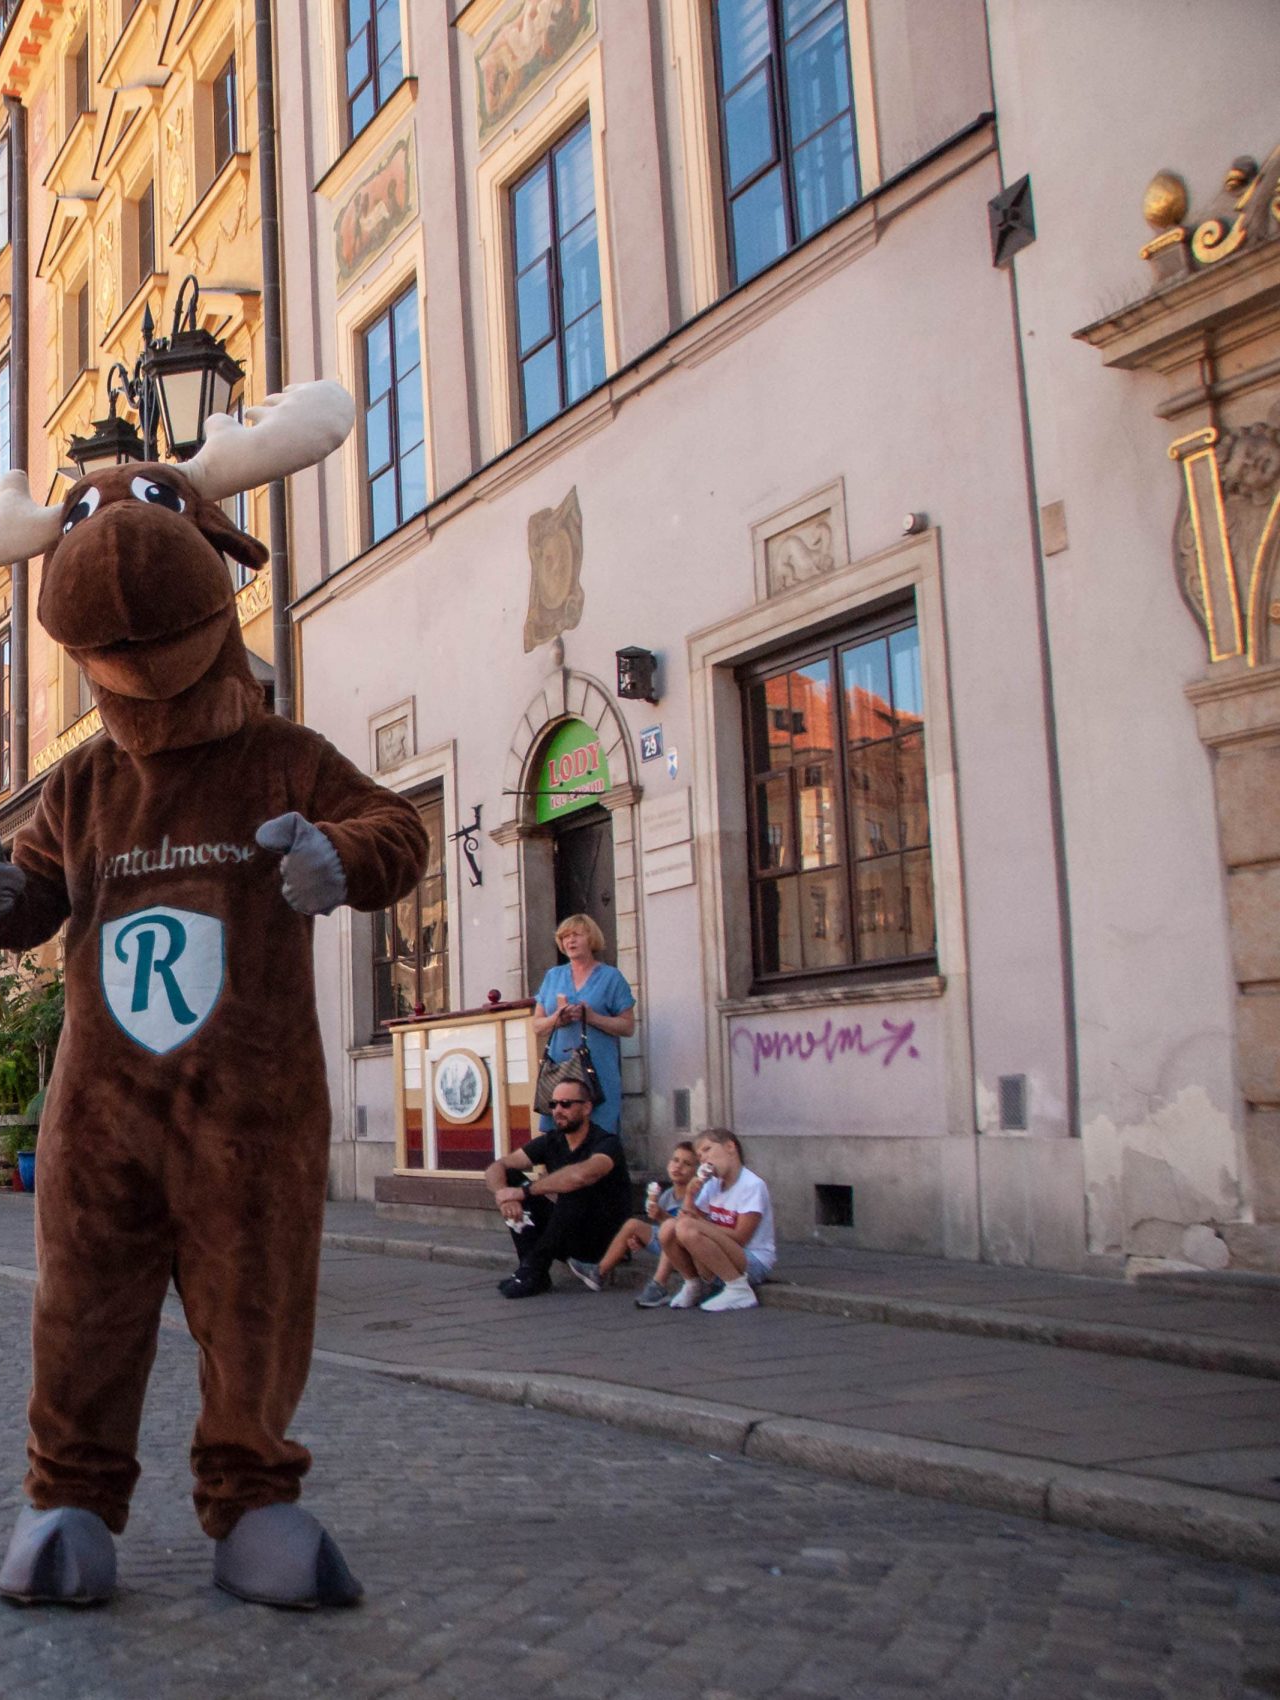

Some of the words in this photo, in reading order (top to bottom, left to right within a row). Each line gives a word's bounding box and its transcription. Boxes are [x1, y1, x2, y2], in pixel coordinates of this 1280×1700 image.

[548, 741, 601, 788] LODY
[645, 739, 657, 757] 29
[115, 914, 198, 1025] R
